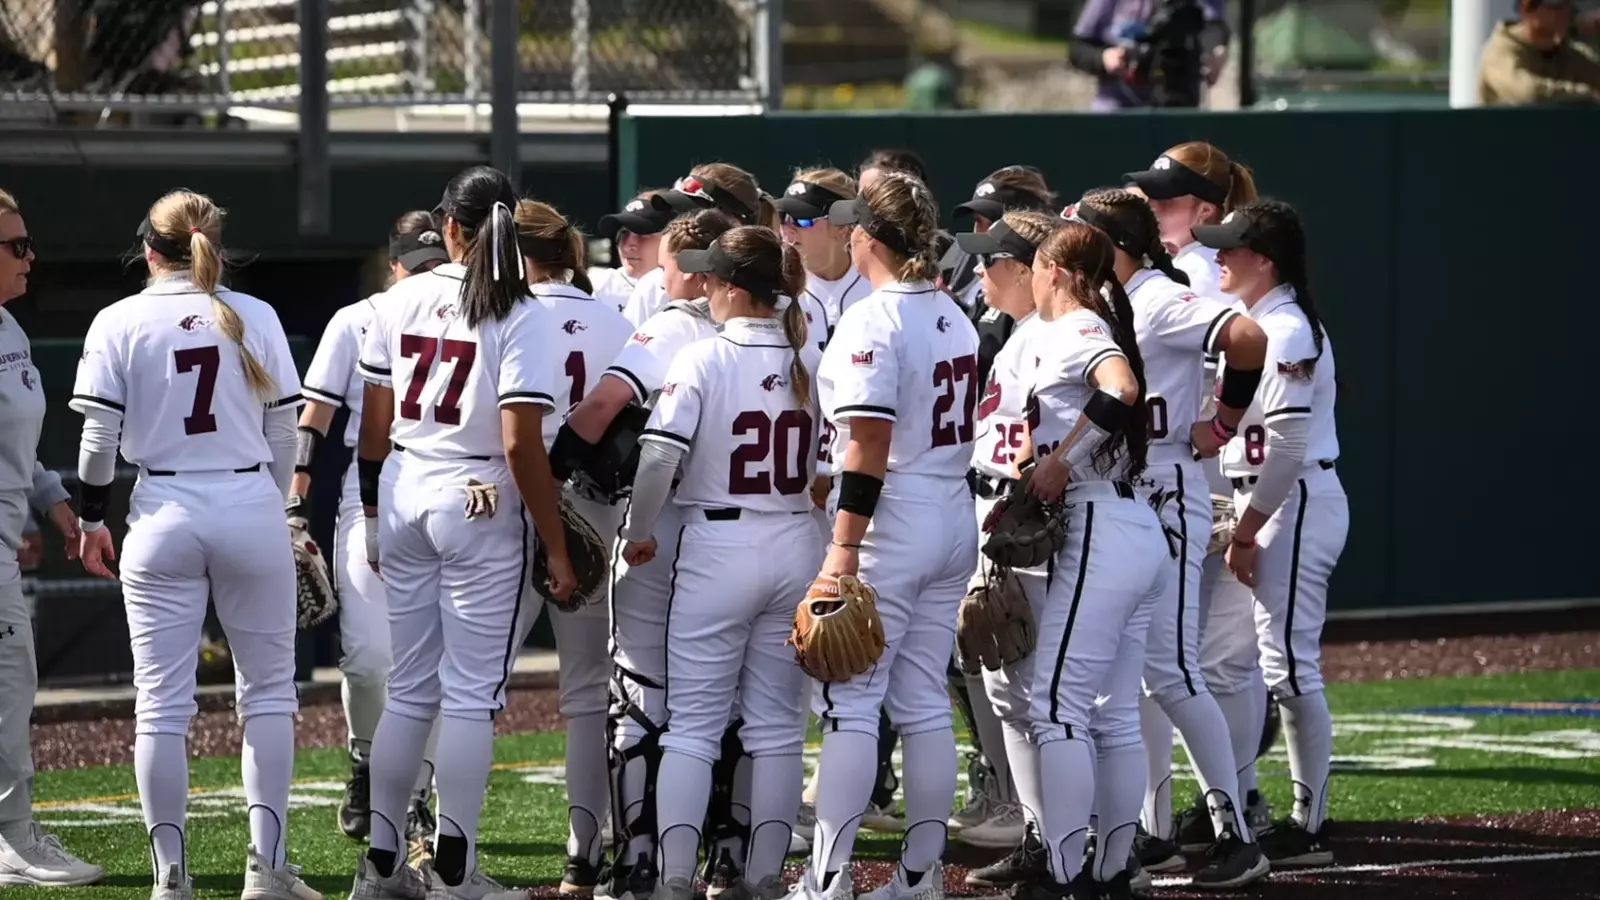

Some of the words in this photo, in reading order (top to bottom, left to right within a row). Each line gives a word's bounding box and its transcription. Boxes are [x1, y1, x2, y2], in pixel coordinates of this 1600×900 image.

[174, 345, 220, 436] 7
[400, 333, 477, 426] 77
[564, 350, 587, 412] 1
[931, 353, 978, 449] 27
[728, 409, 813, 496] 20
[991, 423, 1025, 465] 25
[1244, 424, 1266, 466] 8
